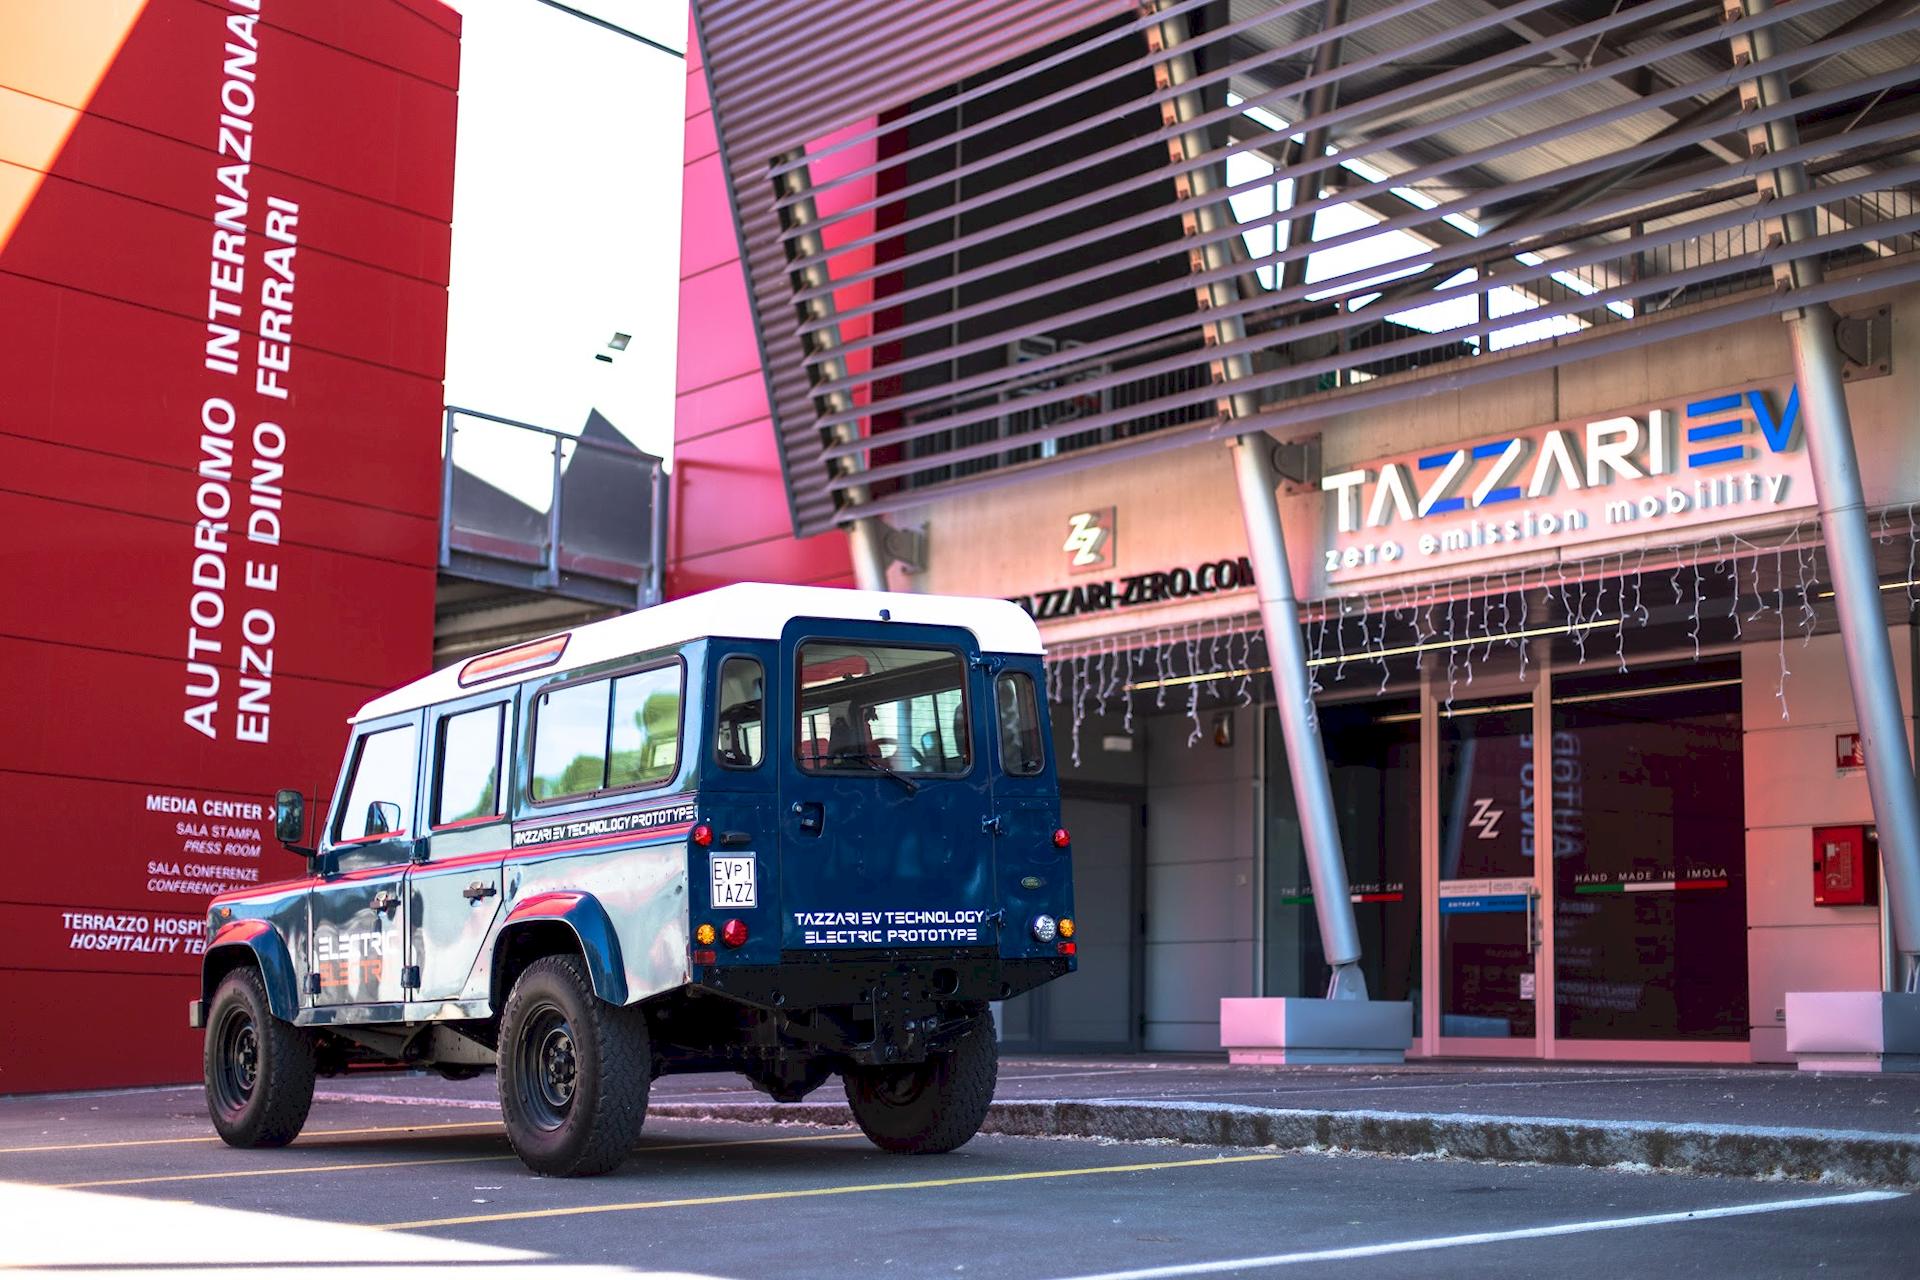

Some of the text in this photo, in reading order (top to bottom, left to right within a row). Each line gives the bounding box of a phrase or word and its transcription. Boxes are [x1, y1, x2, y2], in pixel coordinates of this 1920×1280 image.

[236, 196, 300, 743] ENZO E DINO FERRARI
[1325, 472, 1787, 573] zero emission mobility
[183, 397, 237, 740] AUTODROMO
[146, 795, 262, 820] MEDIA CENTER
[176, 822, 261, 841] SALA STAMPA
[567, 814, 631, 837] TECHNOLOGY
[631, 806, 694, 828] PROTOTYPE
[184, 839, 262, 858] PRESS ROOM
[147, 860, 259, 881] SALA CONFERENZE
[1574, 868, 1728, 883] HAND MADE IN IMOLA
[147, 877, 226, 896] CONFERENCE
[715, 883, 754, 903] TAZZ
[62, 912, 149, 933] TERRAZZO
[794, 910, 984, 926] TAZZARI EV TECHNOLOGY
[70, 933, 179, 953] HOSPITALITY
[805, 928, 977, 944] ELECTRIC PROTOTYPE
